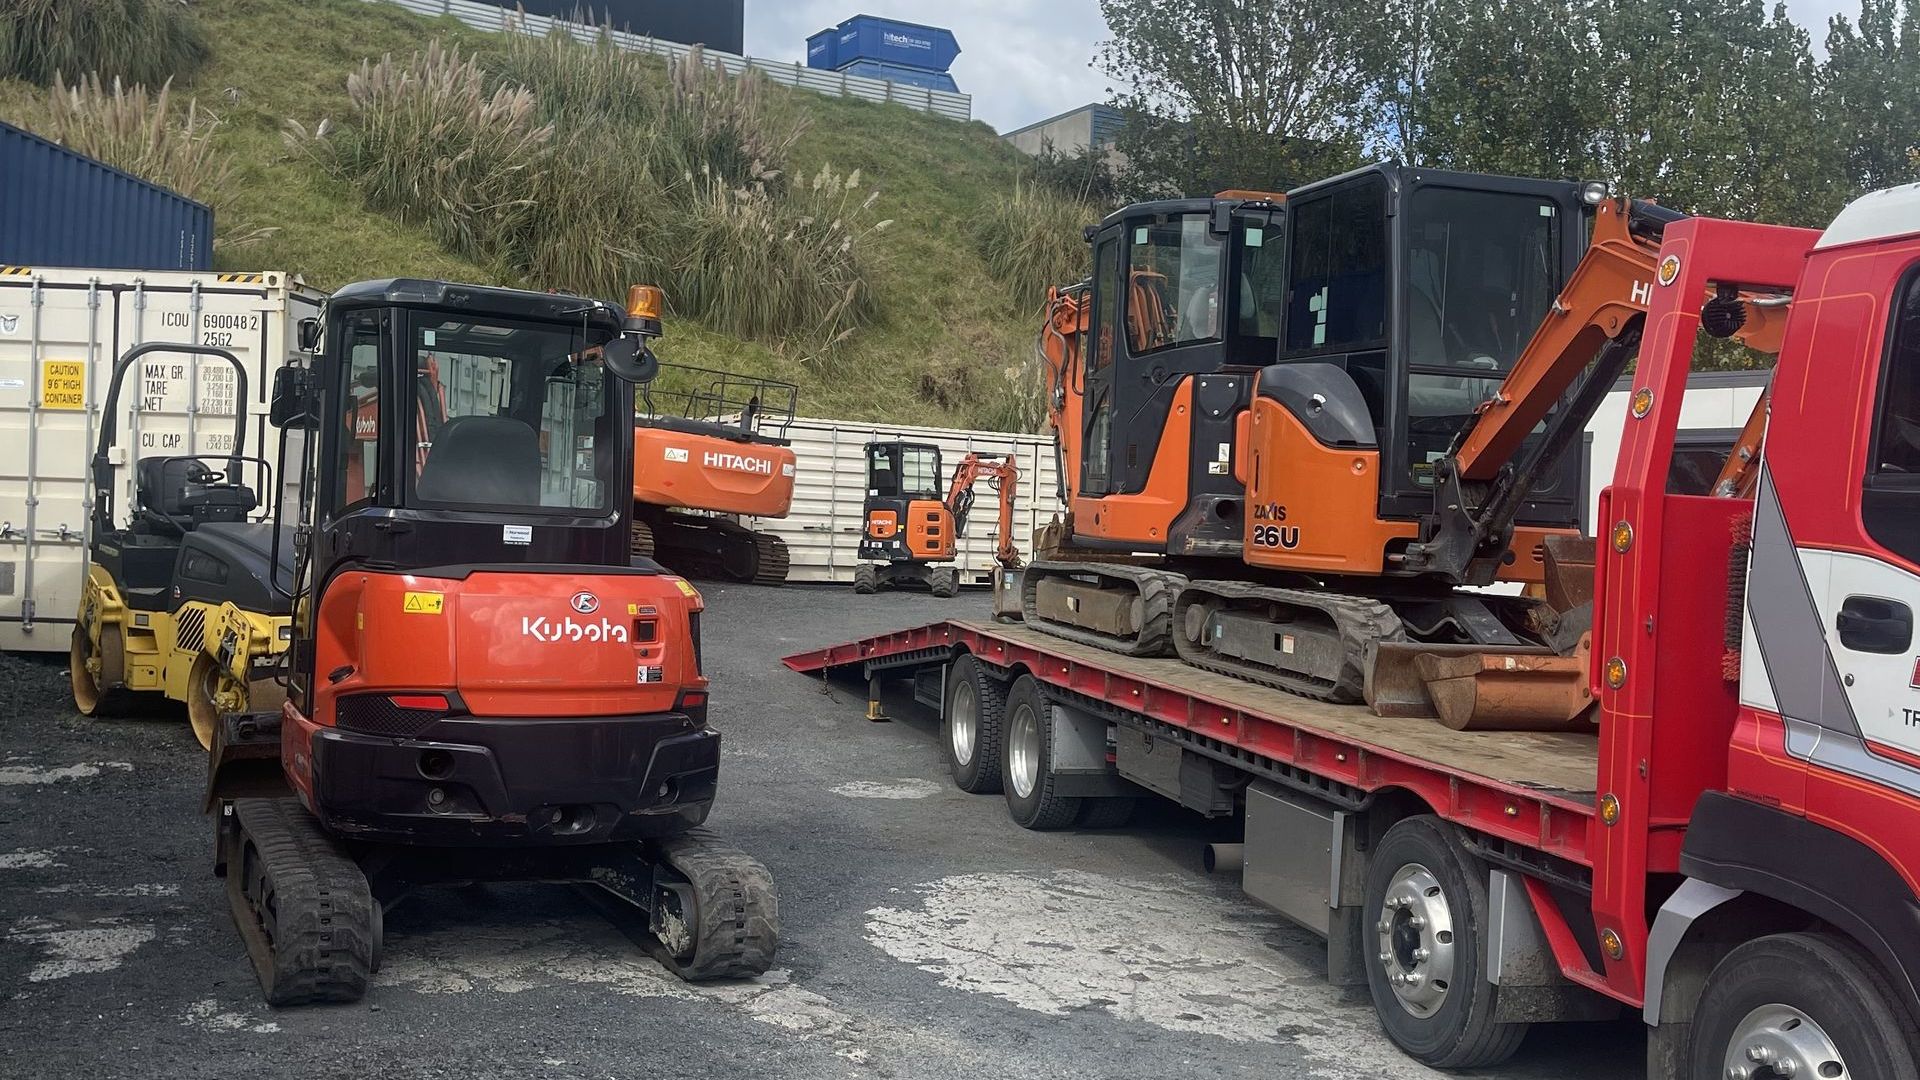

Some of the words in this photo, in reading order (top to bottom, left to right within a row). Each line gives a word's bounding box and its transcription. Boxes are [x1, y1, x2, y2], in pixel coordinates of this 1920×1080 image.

[203, 314, 247, 330] 690048
[250, 316, 258, 330] 2
[203, 332, 232, 347] 25G2
[50, 365, 79, 375] CAUTION
[63, 380, 80, 390] HIGH
[145, 380, 168, 395] TARE
[45, 393, 82, 404] CONTAINER
[144, 396, 163, 411] NET
[704, 452, 771, 474] HITACHI
[1254, 502, 1286, 521] ZAXIS
[1254, 524, 1299, 549] 26U
[522, 616, 628, 642] Kubota
